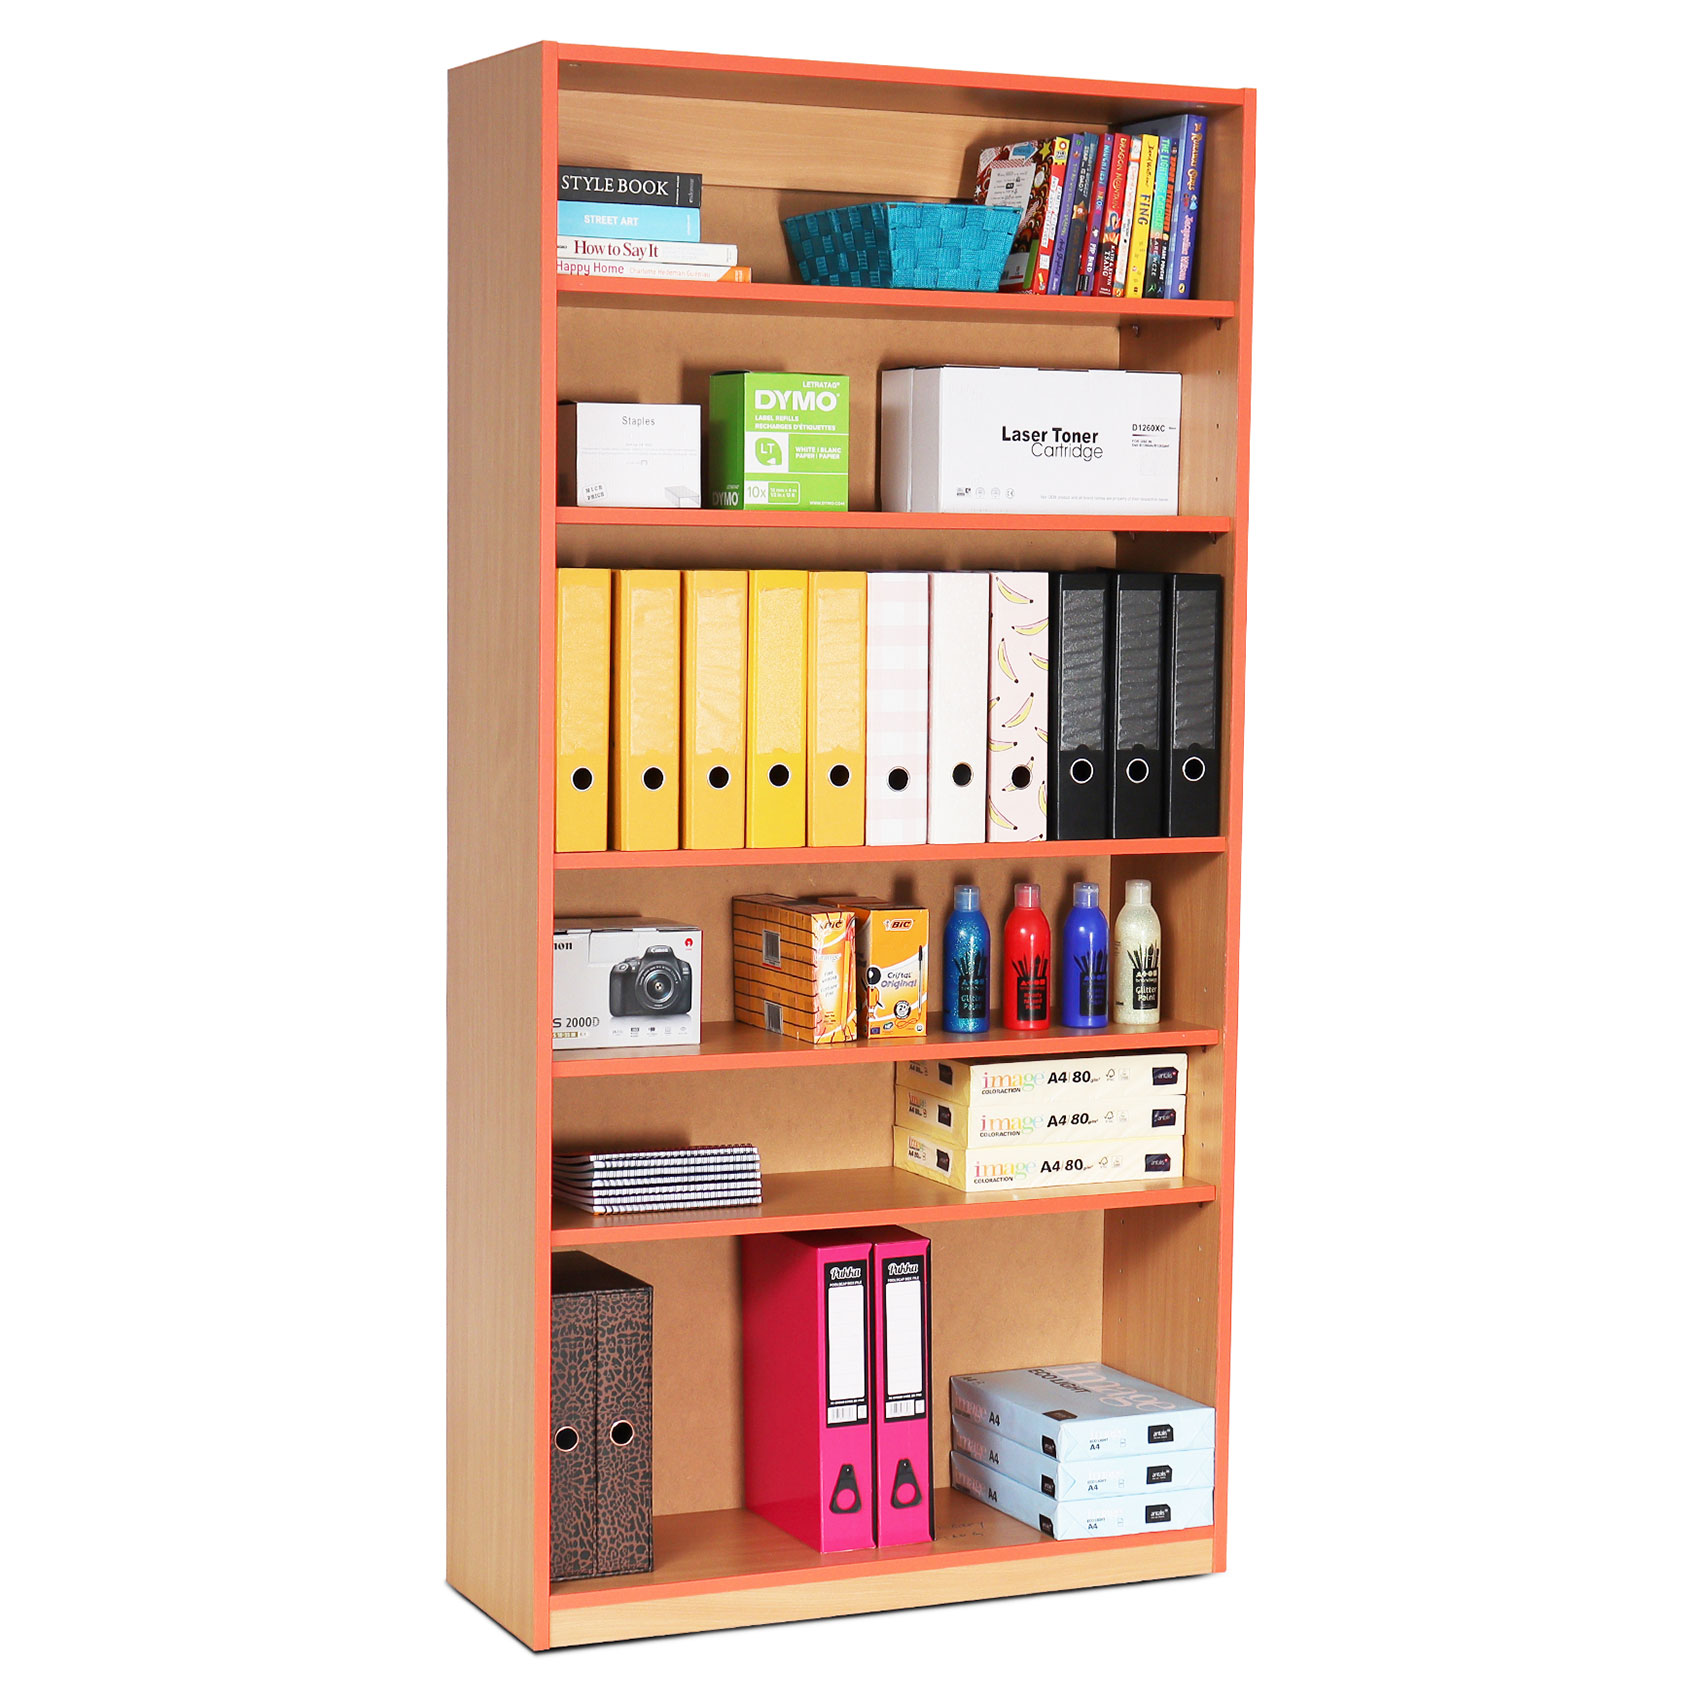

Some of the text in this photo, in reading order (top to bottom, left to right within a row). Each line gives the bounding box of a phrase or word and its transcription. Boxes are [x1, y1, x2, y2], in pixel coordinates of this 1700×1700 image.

[1160, 138, 1171, 154] THE
[1118, 138, 1127, 171] DRAGON
[561, 174, 615, 193] STYLE
[617, 178, 669, 196] BOOK
[1138, 194, 1152, 226] FING
[583, 214, 639, 226] STREET ART
[574, 240, 659, 260] How to Say It
[556, 260, 624, 276] Happy Home
[1102, 251, 1110, 277] TSANG
[755, 389, 837, 412] DYMO
[621, 416, 656, 427] Staples
[1002, 426, 1098, 443] Laser Toner
[760, 442, 775, 454] LT
[1031, 442, 1103, 462] Cartridge
[712, 491, 739, 506] DYMO
[747, 486, 767, 498] 10x
[881, 979, 917, 990] Original
[566, 1017, 600, 1028] 2000D
[983, 1071, 1045, 1091] image
[1047, 1071, 1068, 1084] A4
[981, 1114, 1044, 1135] image
[1047, 1115, 1067, 1128] A4
[979, 1130, 1021, 1138] COLORACTION
[974, 1160, 1037, 1180] image
[1040, 1160, 1061, 1173] A4
[973, 1176, 1013, 1184] COLORACTION
[829, 1266, 861, 1280] Pukka
[887, 1262, 919, 1275] Pukka
[1046, 1365, 1177, 1412] image
[988, 1411, 1000, 1426] A4
[988, 1449, 999, 1465] A4
[988, 1487, 998, 1503] A4
